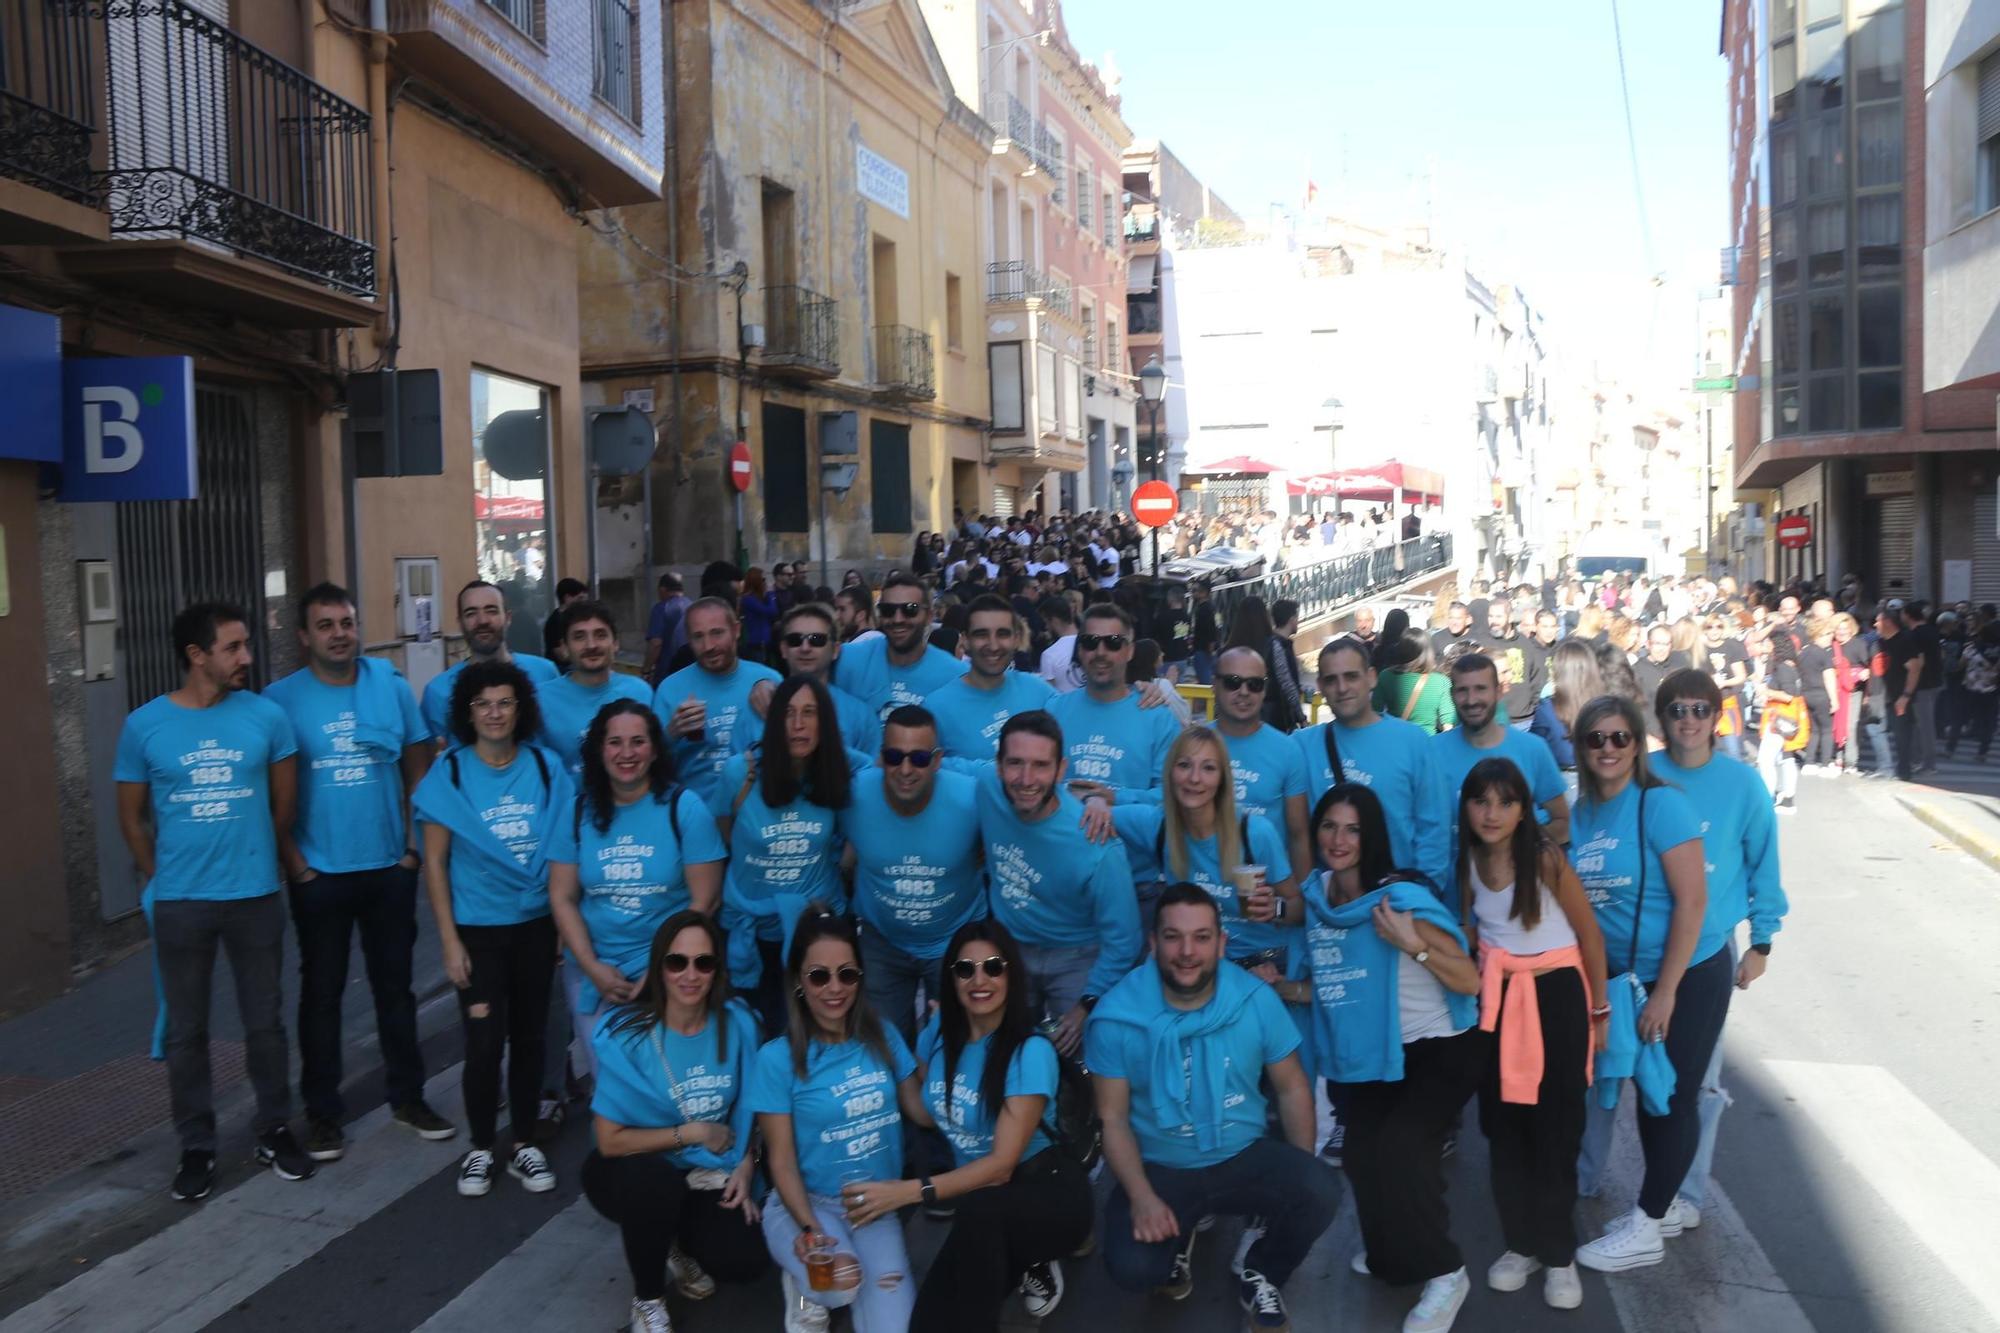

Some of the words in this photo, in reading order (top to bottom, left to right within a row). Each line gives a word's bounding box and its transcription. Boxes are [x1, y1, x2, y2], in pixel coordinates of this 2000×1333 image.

[82, 385, 144, 474] B
[178, 748, 244, 768] LEYENDAS
[1069, 743, 1125, 761] LEYENDAS
[188, 766, 233, 785] 1983
[1073, 759, 1112, 778] 1983
[191, 801, 230, 817] EGB
[480, 802, 537, 822] LEYENDAS
[761, 820, 822, 839] LEYENDAS
[597, 844, 655, 861] LEYENDAS
[767, 838, 810, 855] 1983
[601, 861, 643, 880] 1983
[765, 867, 801, 881] EGB
[883, 864, 946, 877] LEYENDAS
[894, 878, 936, 896] 1983
[686, 1065, 706, 1078] LAS
[667, 1074, 732, 1100] LEYENDAS
[829, 1070, 888, 1098] LEYENDAS
[676, 1094, 724, 1117] 1983
[842, 1089, 885, 1118] 1983
[846, 1131, 881, 1156] EGB
